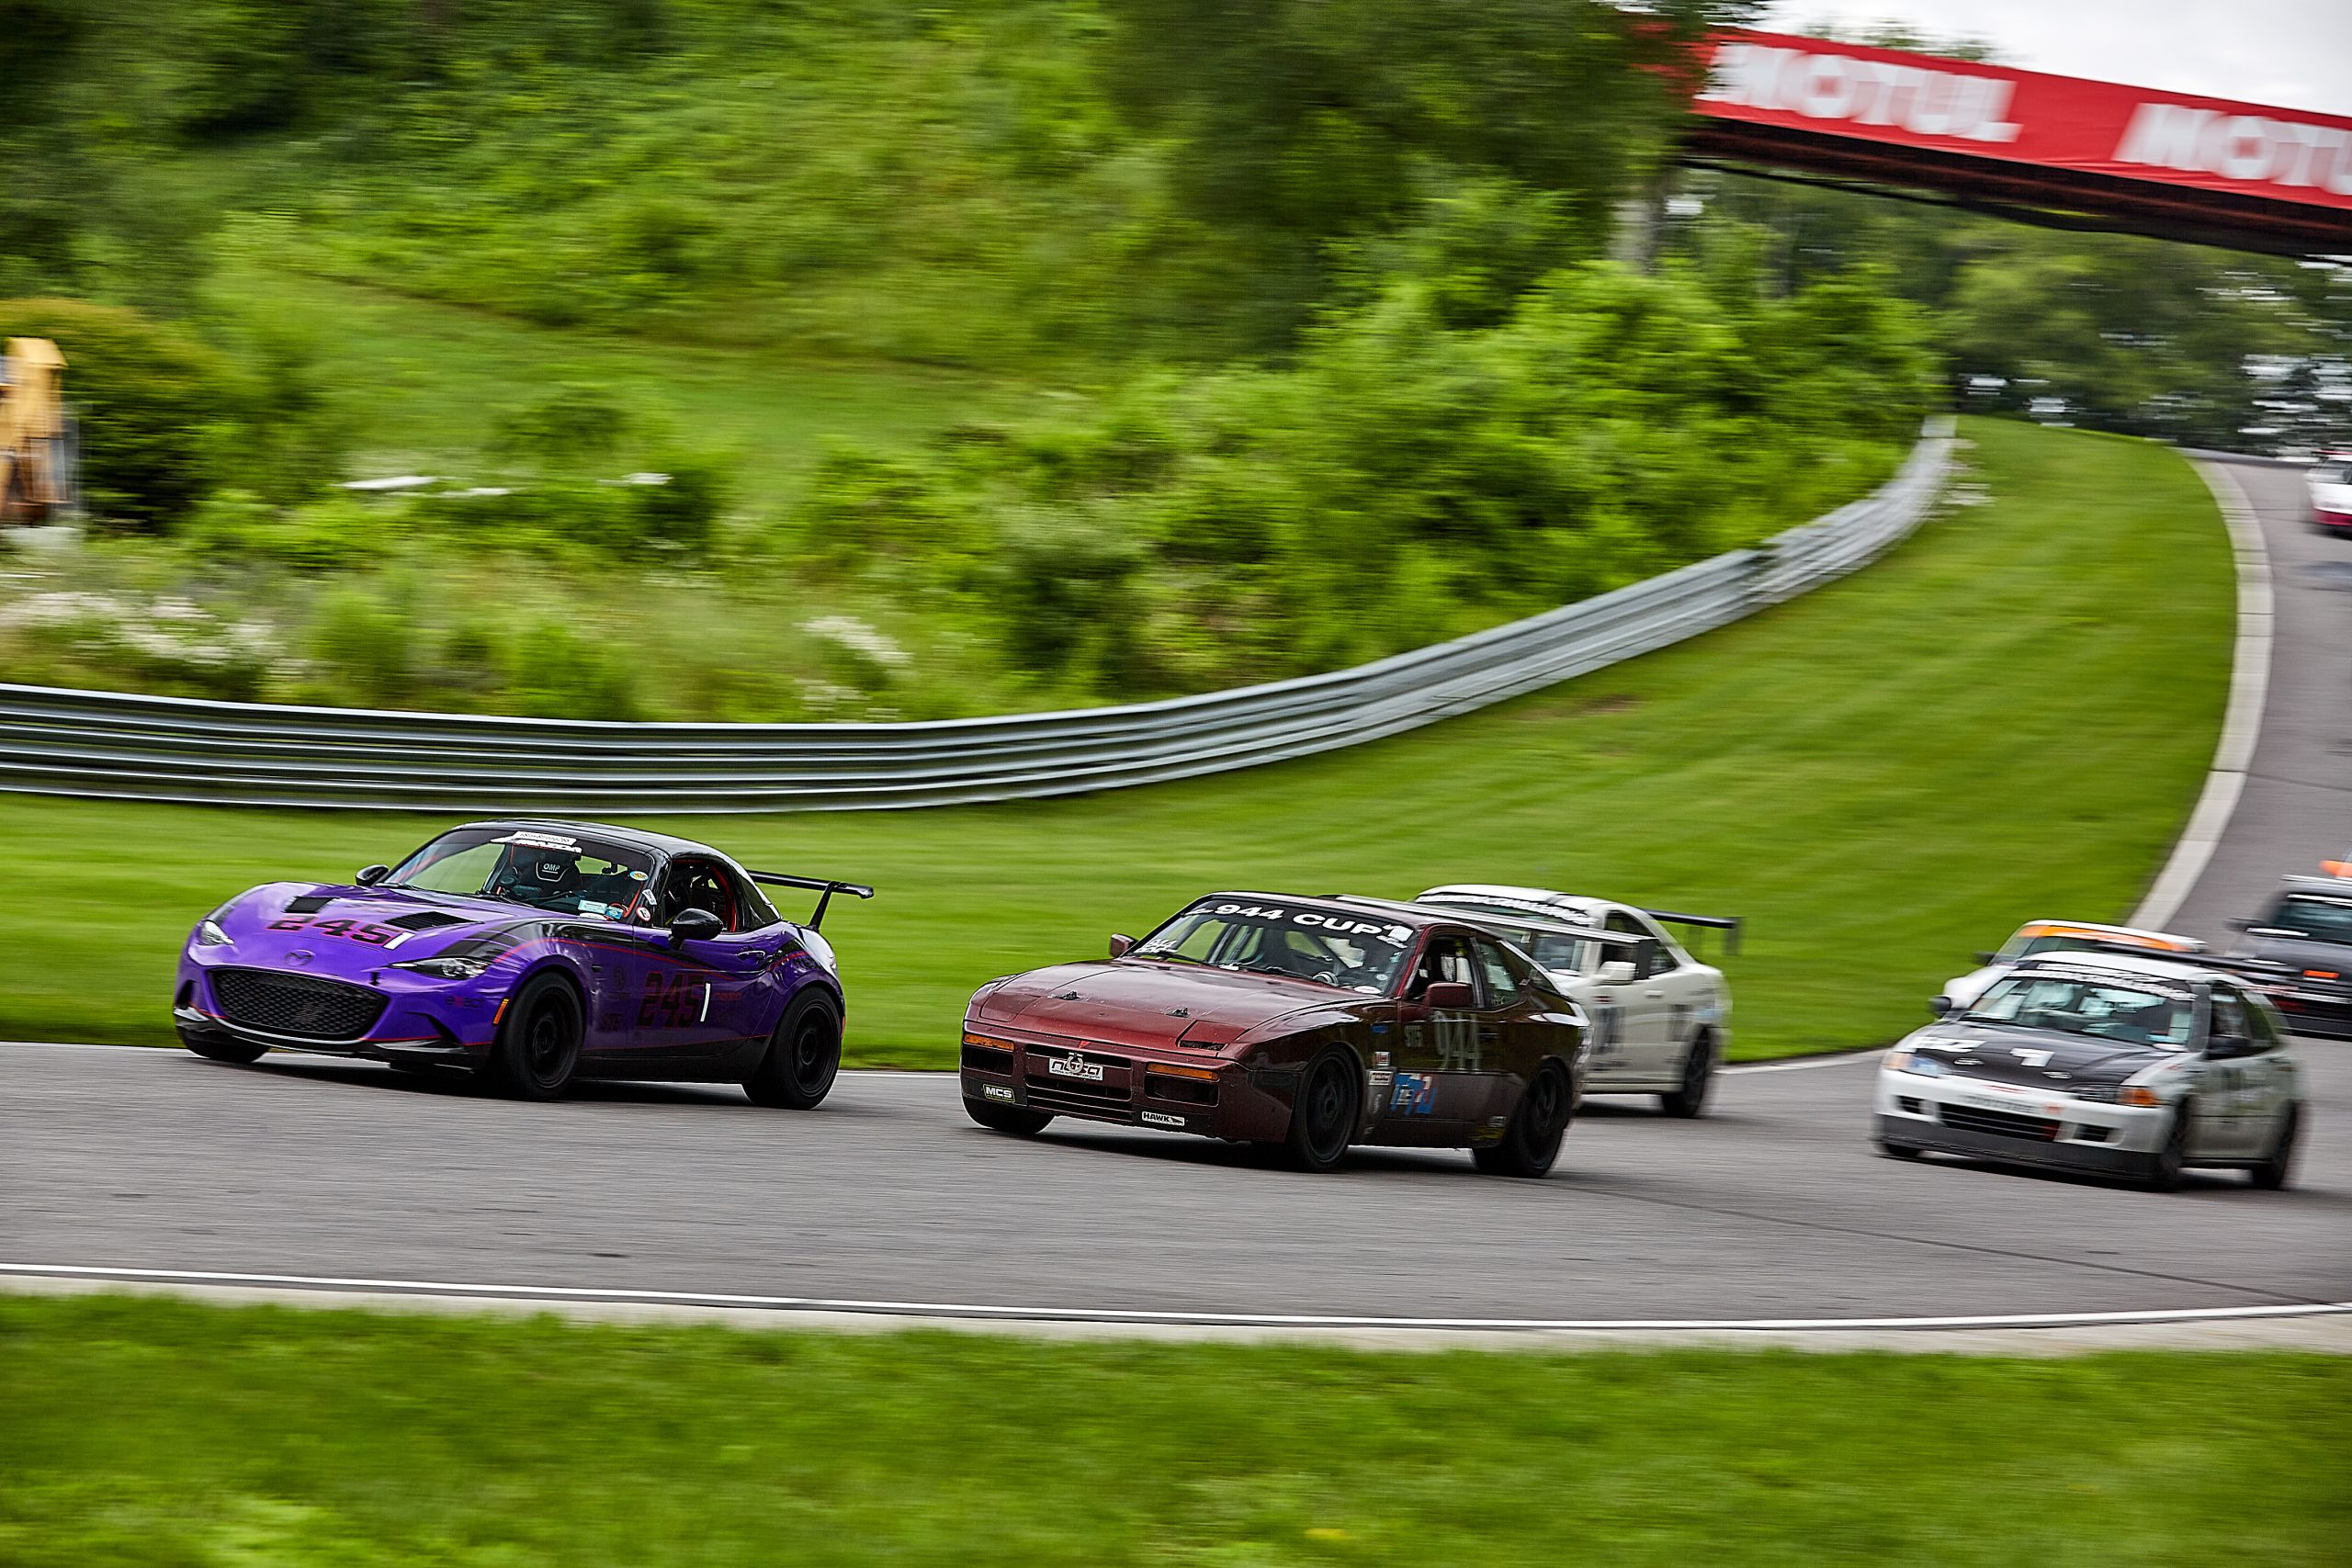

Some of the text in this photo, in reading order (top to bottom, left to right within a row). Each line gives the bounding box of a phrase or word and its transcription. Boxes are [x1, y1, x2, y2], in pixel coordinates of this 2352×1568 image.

[1693, 42, 2024, 143] MOTUL
[542, 863, 560, 872] OMP
[1214, 904, 1383, 934] 944 CUP
[1430, 1010, 1482, 1071] 944
[985, 1086, 1012, 1099] MCS
[1143, 1112, 1170, 1122] HAWK
